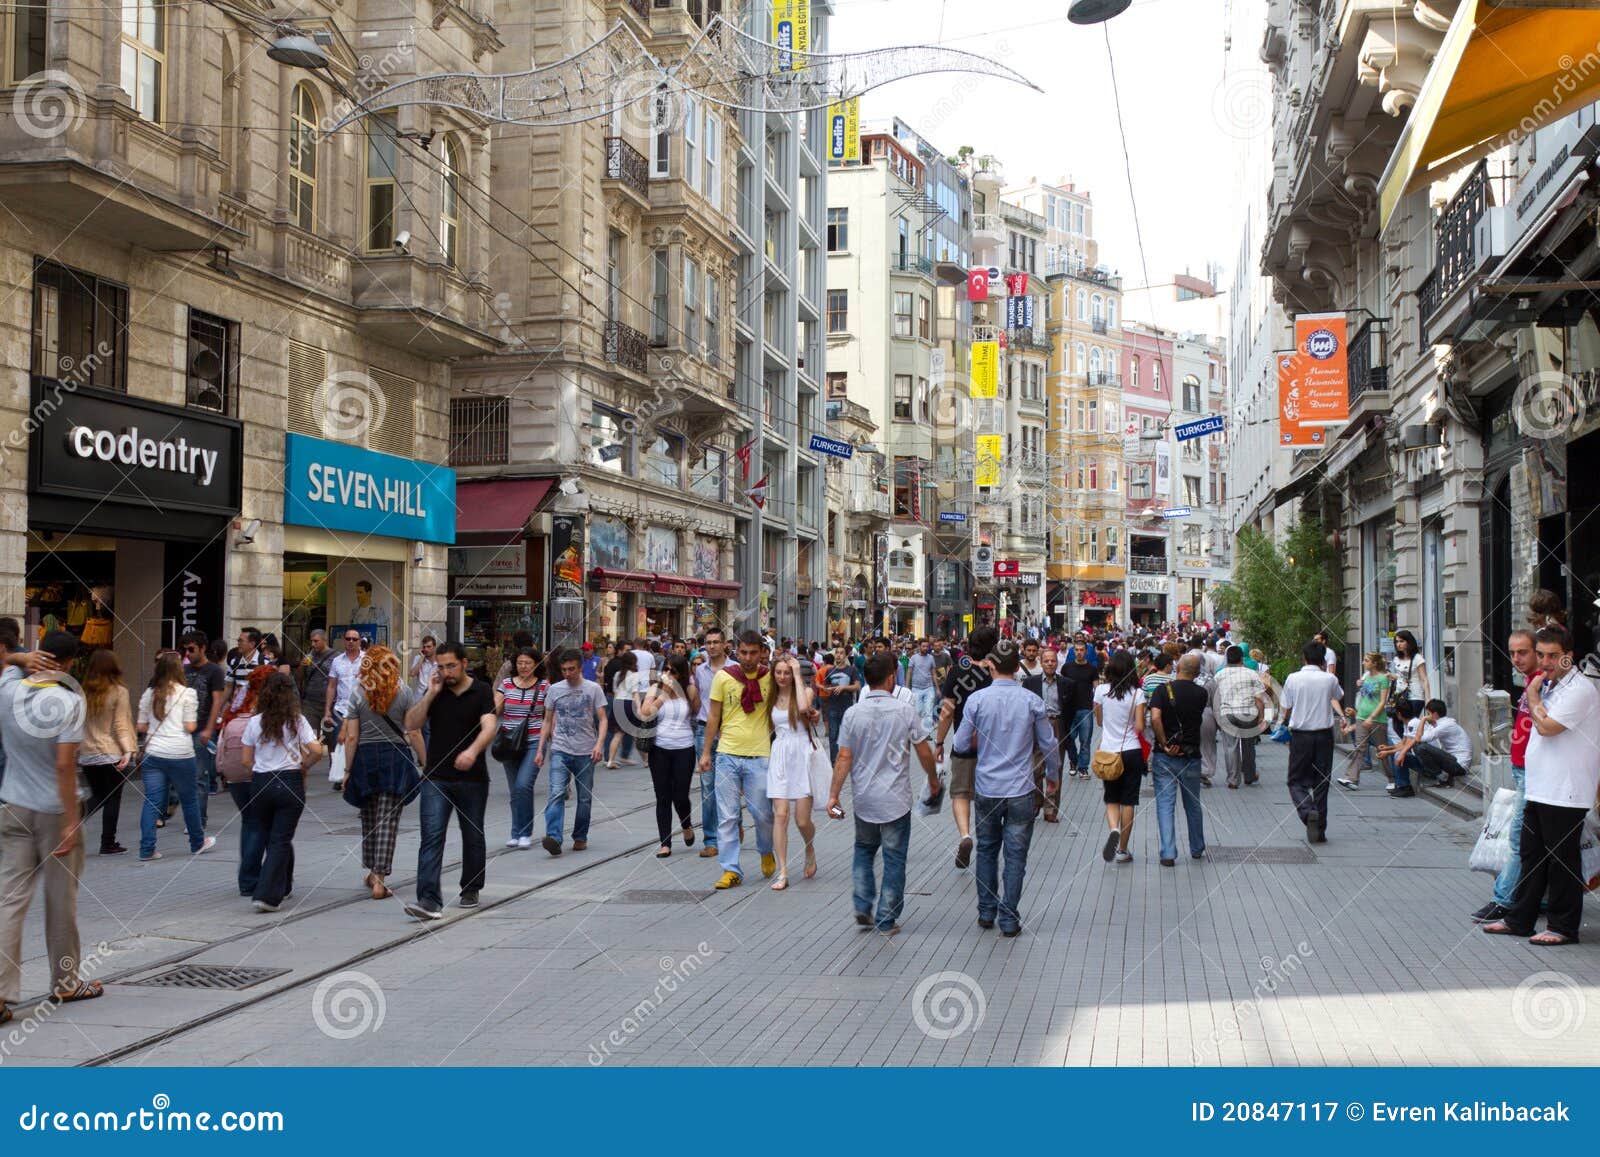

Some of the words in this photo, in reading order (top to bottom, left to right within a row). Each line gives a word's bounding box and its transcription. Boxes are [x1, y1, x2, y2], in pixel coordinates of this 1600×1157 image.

[834, 118, 843, 155] Berlitz
[812, 438, 851, 456] TURKCELL
[1176, 419, 1223, 438] TURKCELL
[72, 425, 218, 486] codentry
[307, 462, 426, 518] SEVENHILL
[181, 569, 203, 636] entry
